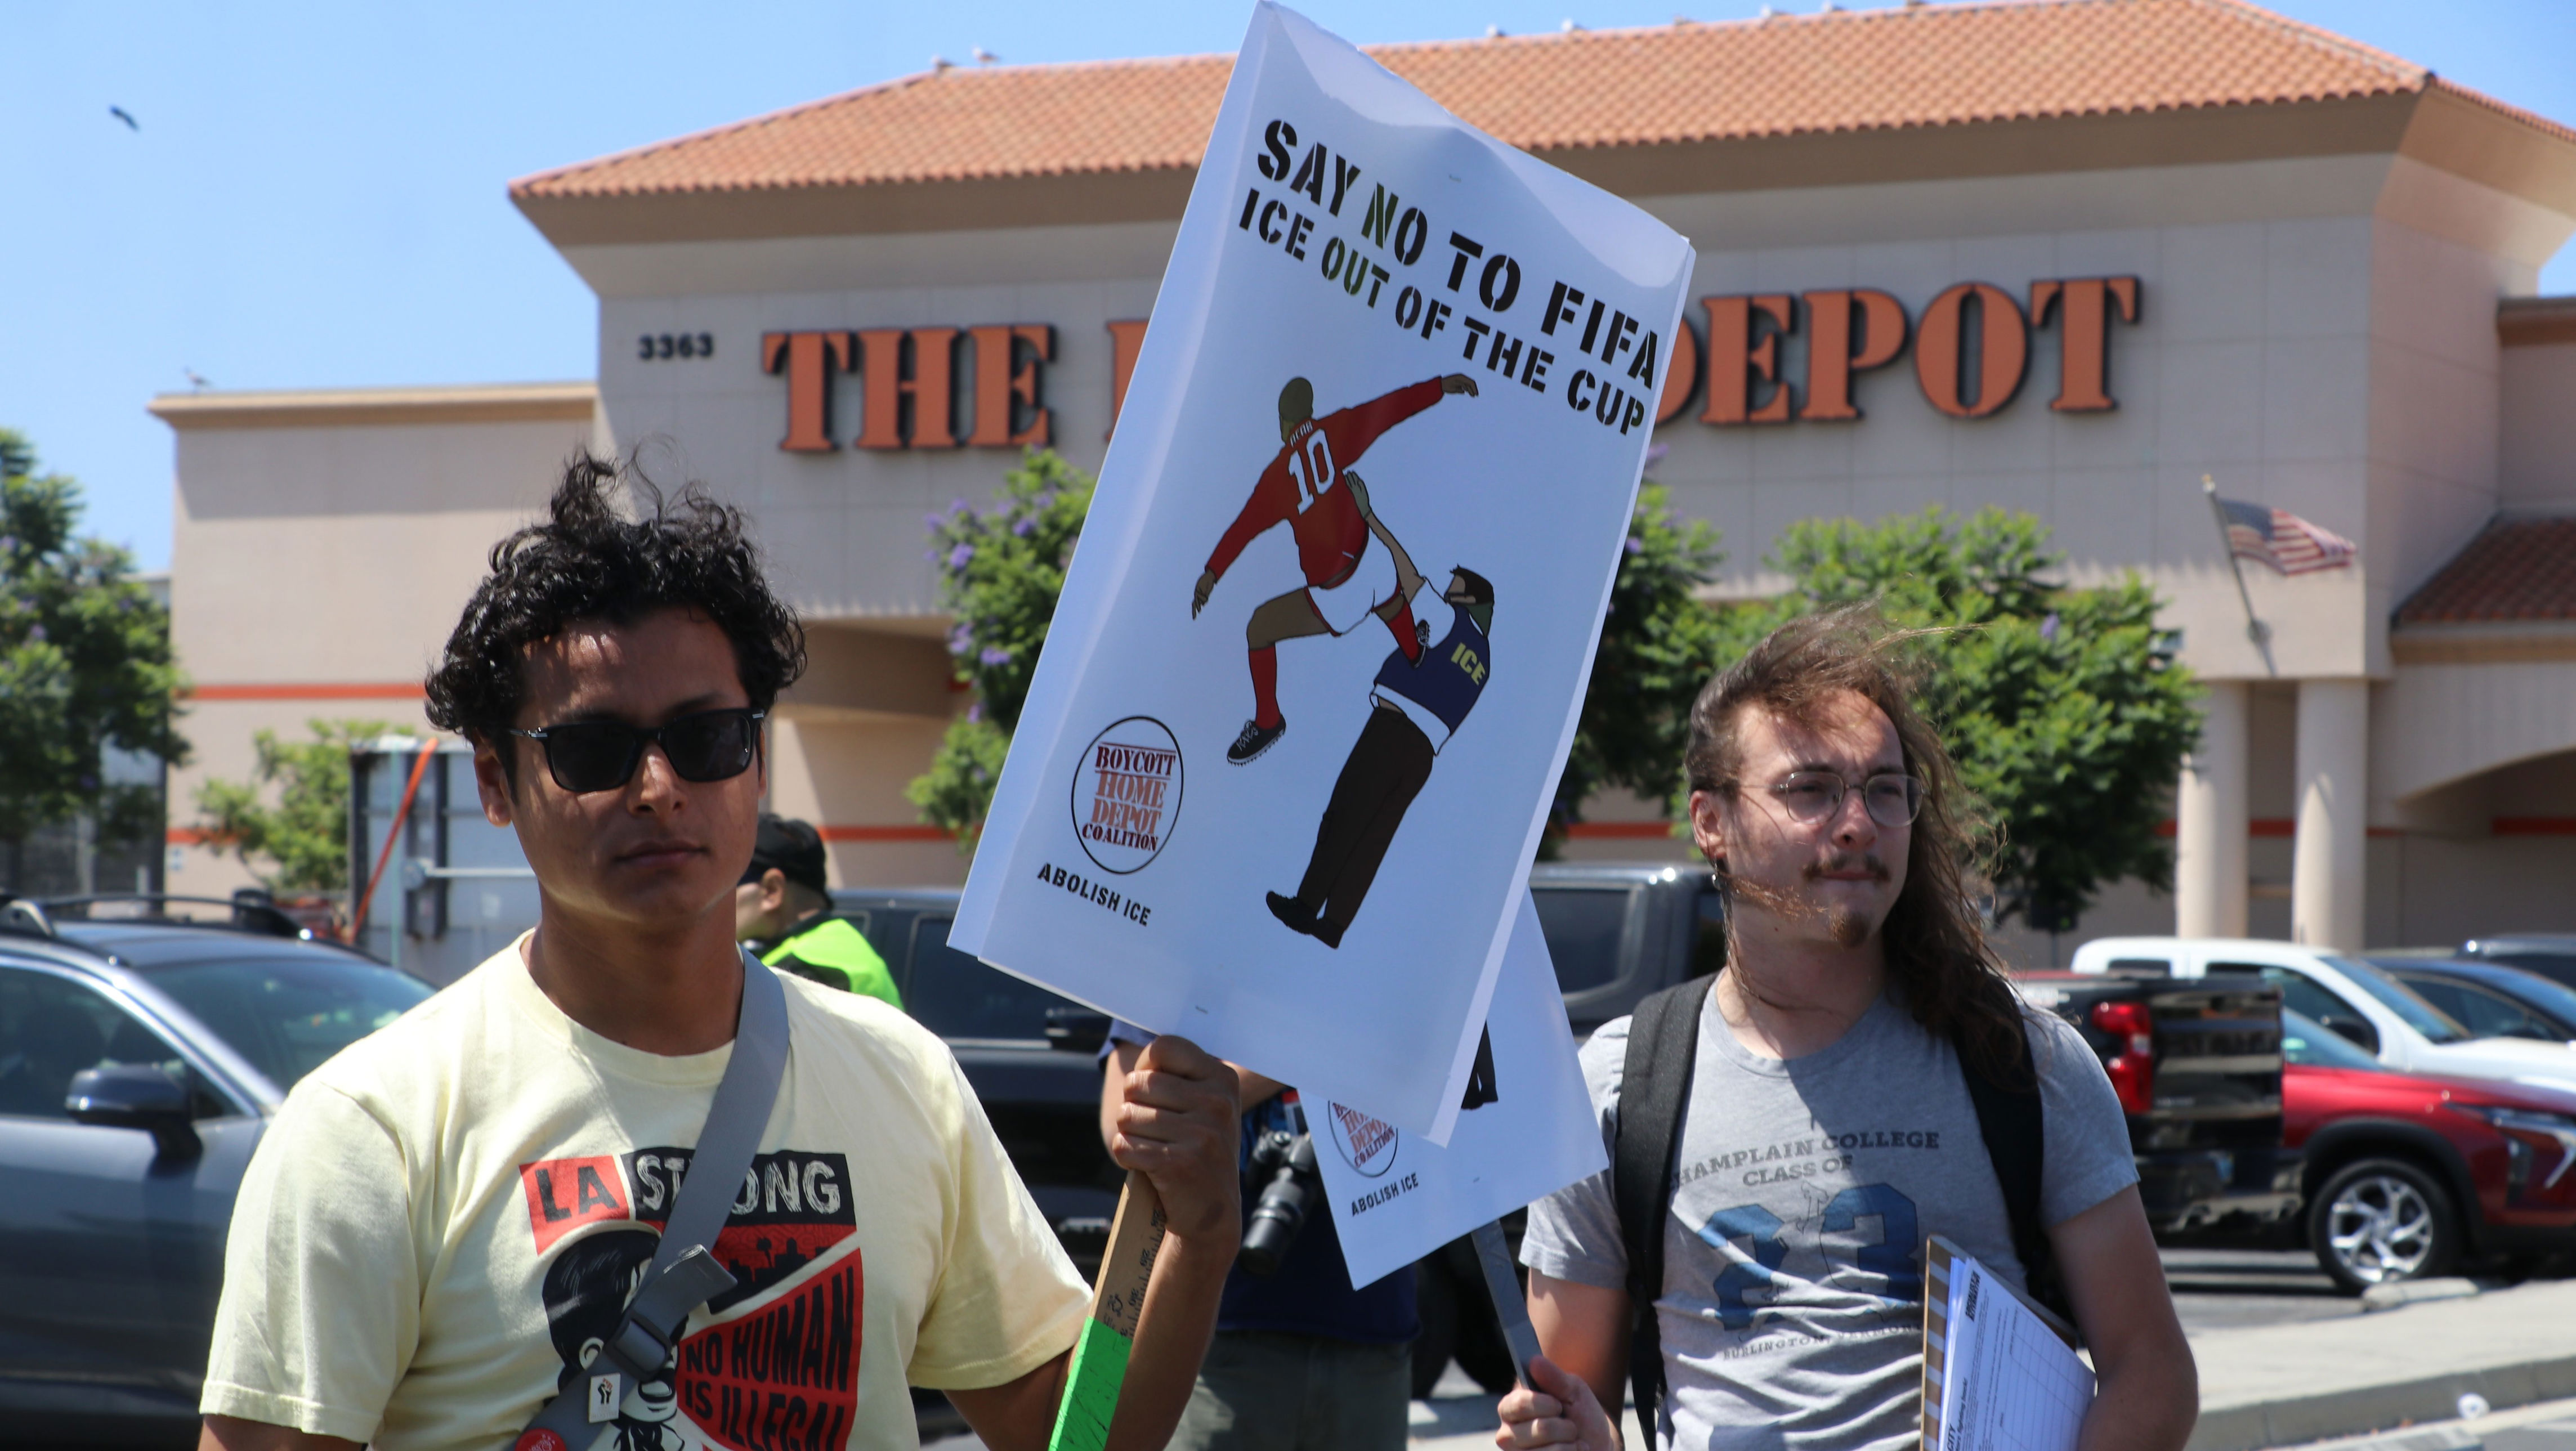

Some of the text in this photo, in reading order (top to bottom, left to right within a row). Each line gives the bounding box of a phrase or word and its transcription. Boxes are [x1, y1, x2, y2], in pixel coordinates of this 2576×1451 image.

[1257, 119, 1658, 389] SAY NO TO FIFA
[1238, 188, 1645, 435] ICE OUT OF THE CUP
[638, 332, 713, 359] 3363
[762, 325, 1052, 450] THE
[1288, 428, 1336, 515] 10
[1451, 642, 1486, 686] ICE
[1095, 745, 1176, 776] BOYCOTT
[1095, 771, 1167, 809] HOME
[1082, 823, 1159, 852] COALITION
[1091, 798, 1162, 835] DEPOT
[1037, 863, 1151, 926] ABOLISH ICE
[1671, 1131, 1939, 1187] HAMPLAIN COLLEGE
[1742, 1154, 1853, 1186] CLASS OF
[535, 1154, 840, 1222] LA STONG
[1352, 1173, 1419, 1216] ABOLISH ICE
[685, 1265, 853, 1392] NO HUMAN
[685, 1380, 713, 1421] IS
